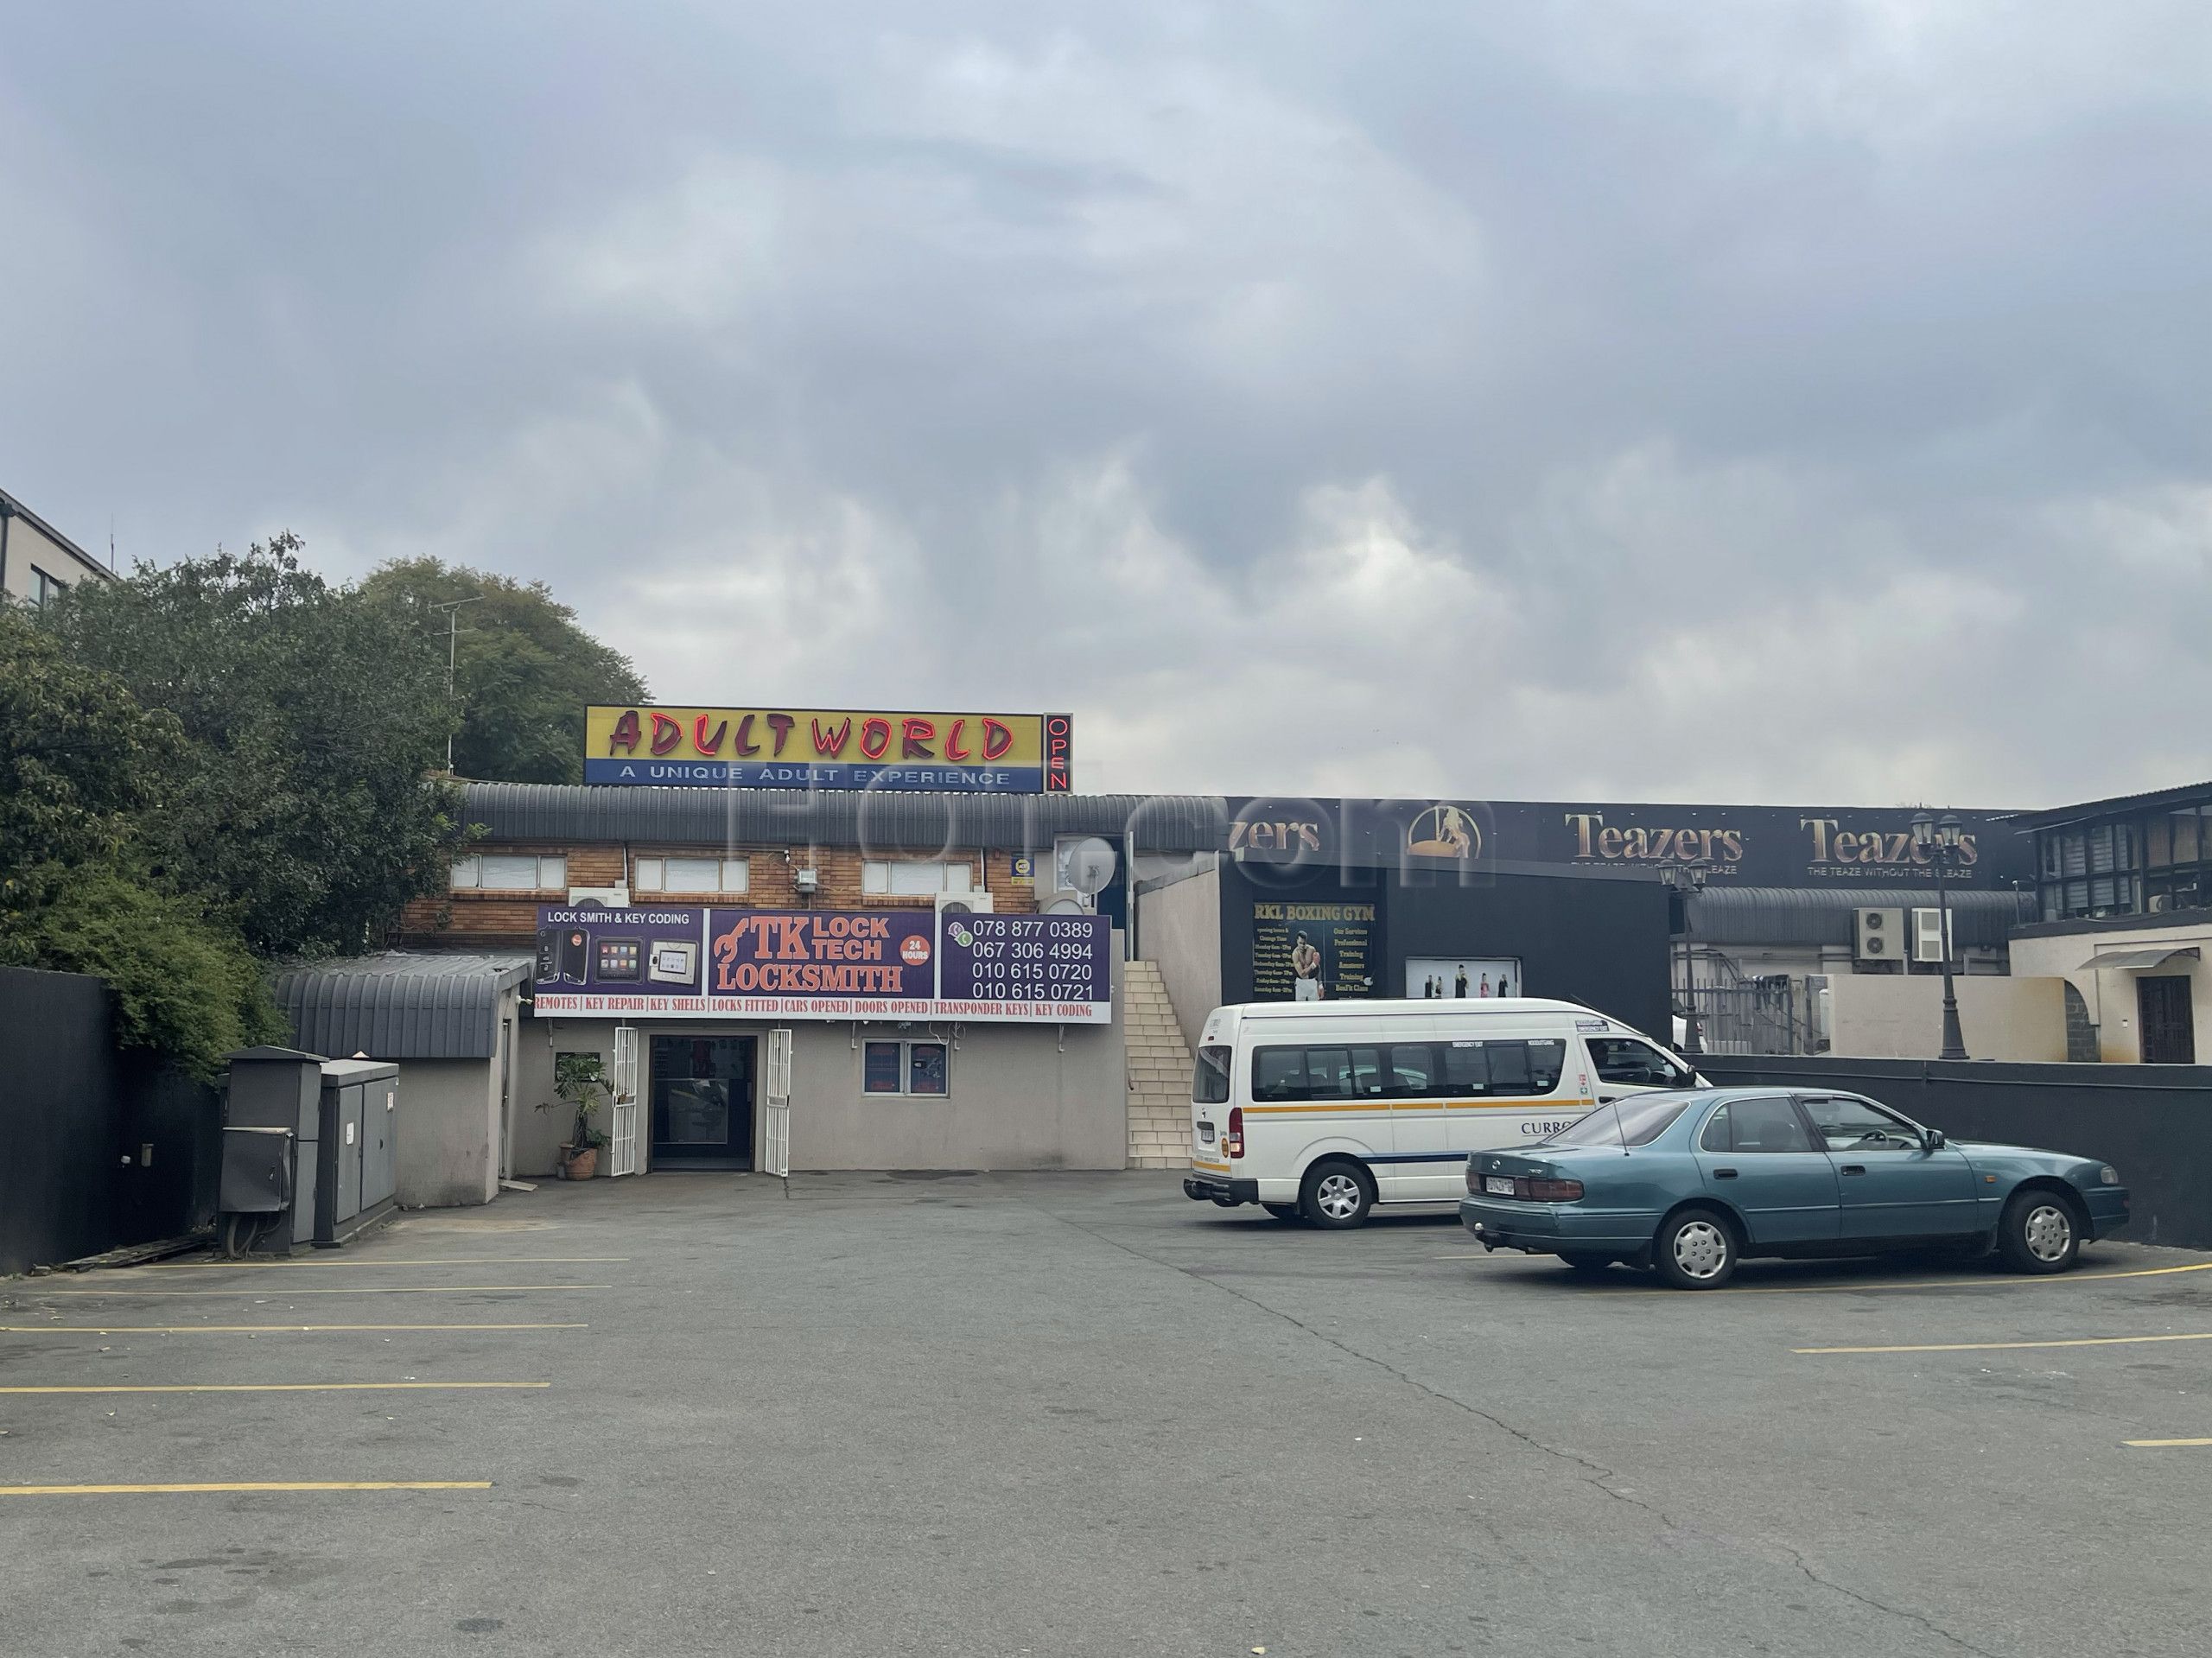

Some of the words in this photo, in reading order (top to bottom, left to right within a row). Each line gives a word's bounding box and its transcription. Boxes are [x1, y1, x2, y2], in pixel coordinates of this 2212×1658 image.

[610, 710, 794, 756] ADULT
[811, 717, 1013, 760] WORLD
[1048, 719, 1068, 789] OPEN
[620, 766, 636, 778] A
[650, 766, 742, 779] UNIQUE
[759, 768, 839, 781] ADULT
[854, 770, 1009, 785] EXPERIENCE
[1565, 814, 1743, 861] Teazers
[1831, 867, 1860, 876] TEAZE
[1865, 868, 1910, 878] WITHOUT
[1912, 868, 1932, 877] THE
[548, 912, 577, 923] LOCK
[580, 912, 612, 924] SMITH
[614, 912, 622, 924] &
[625, 913, 646, 924] KEY
[648, 913, 690, 924] CODING
[1254, 905, 1284, 919] RKL
[1287, 905, 1341, 920] BOXING
[1343, 905, 1375, 921] GYM
[750, 916, 810, 960] TK
[812, 917, 890, 938] LOCK
[973, 920, 1006, 937] 078
[1011, 921, 1044, 937] 877
[1049, 922, 1093, 938] 0389
[811, 939, 882, 961] TECH
[909, 940, 921, 950] 24
[972, 942, 1005, 958] 067
[1011, 943, 1044, 959] 306
[1048, 943, 1093, 960] 4994
[902, 950, 929, 961] HOURS
[717, 962, 903, 993] LOCKSMITH
[972, 962, 1005, 979] 010
[1010, 963, 1044, 979] 615
[1048, 963, 1092, 980] 0720
[972, 982, 1006, 999] 010
[1011, 983, 1045, 1000] 615
[1051, 984, 1093, 1001] 0721
[534, 997, 577, 1010] REMOTES
[586, 997, 605, 1010] KEY
[607, 997, 645, 1010] REPAIR
[650, 998, 669, 1011] KEY
[672, 998, 705, 1011] SHELLS
[712, 999, 741, 1012] LOCKS
[745, 1000, 778, 1012] FITTED
[785, 1000, 808, 1013] CARS
[811, 1000, 849, 1013] OPENED
[855, 1001, 887, 1013] DOORS
[891, 1001, 927, 1013] OPENED
[934, 1002, 1002, 1015] TRANSPONDER
[1005, 1004, 1028, 1016] KEYS
[1035, 1004, 1053, 1016] KEY
[1056, 1004, 1092, 1017] CODING
